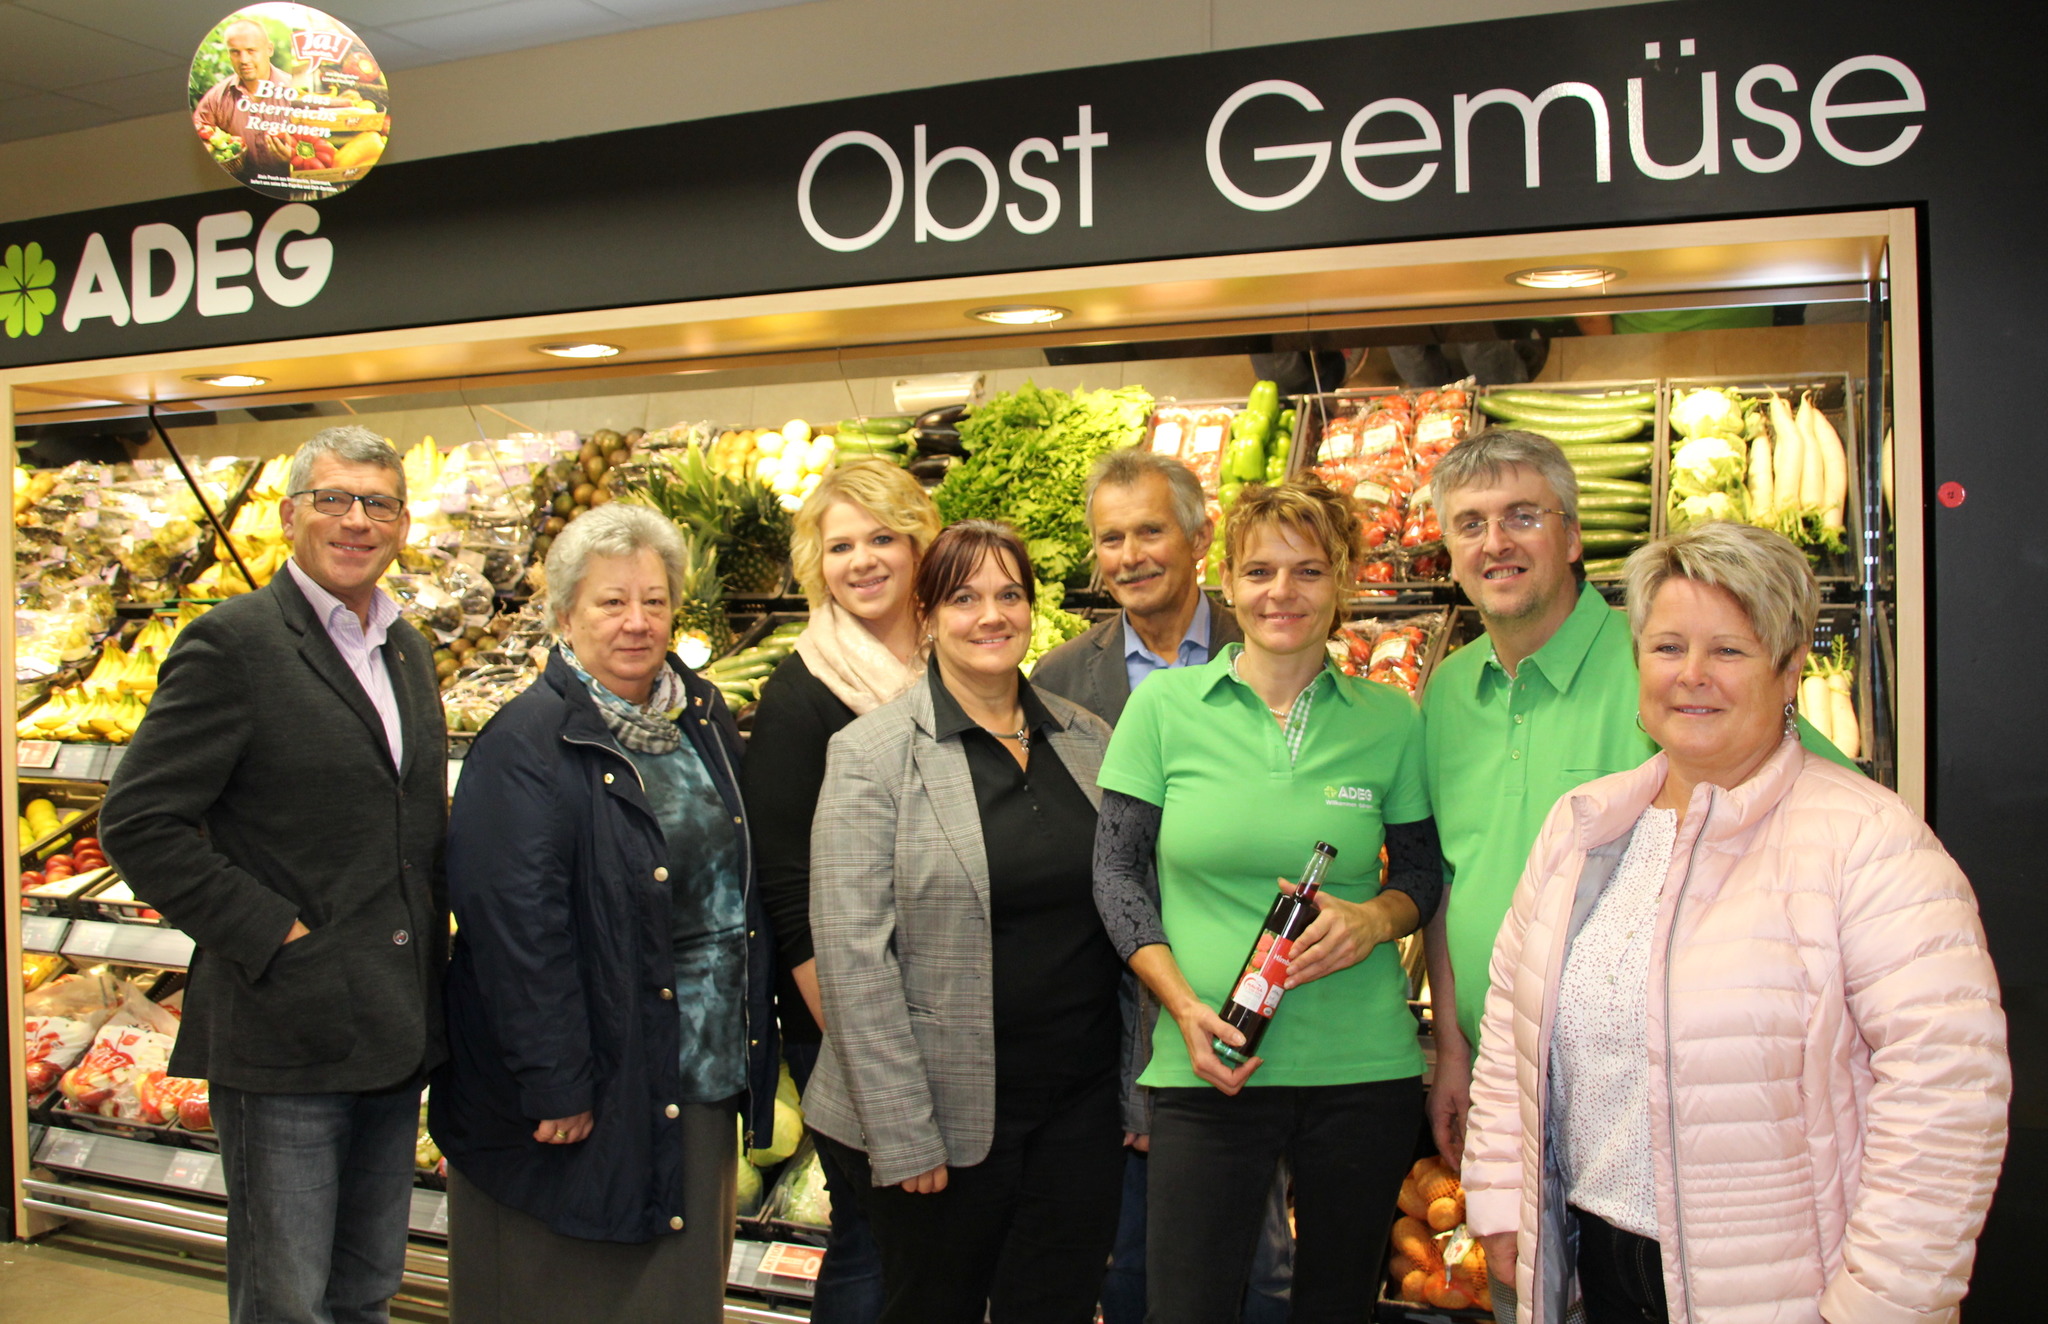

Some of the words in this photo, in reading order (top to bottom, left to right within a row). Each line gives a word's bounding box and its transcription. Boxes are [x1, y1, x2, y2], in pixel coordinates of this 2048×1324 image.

[254, 79, 299, 101] Bio
[302, 94, 331, 106] aus
[236, 95, 338, 122] Österreichs
[245, 115, 332, 138] Regionen
[797, 104, 1109, 252] Obst
[1205, 38, 1927, 212] Gemüse
[62, 203, 334, 332] ADEG
[1338, 786, 1372, 801] ADEG
[1273, 953, 1293, 967] Himb
